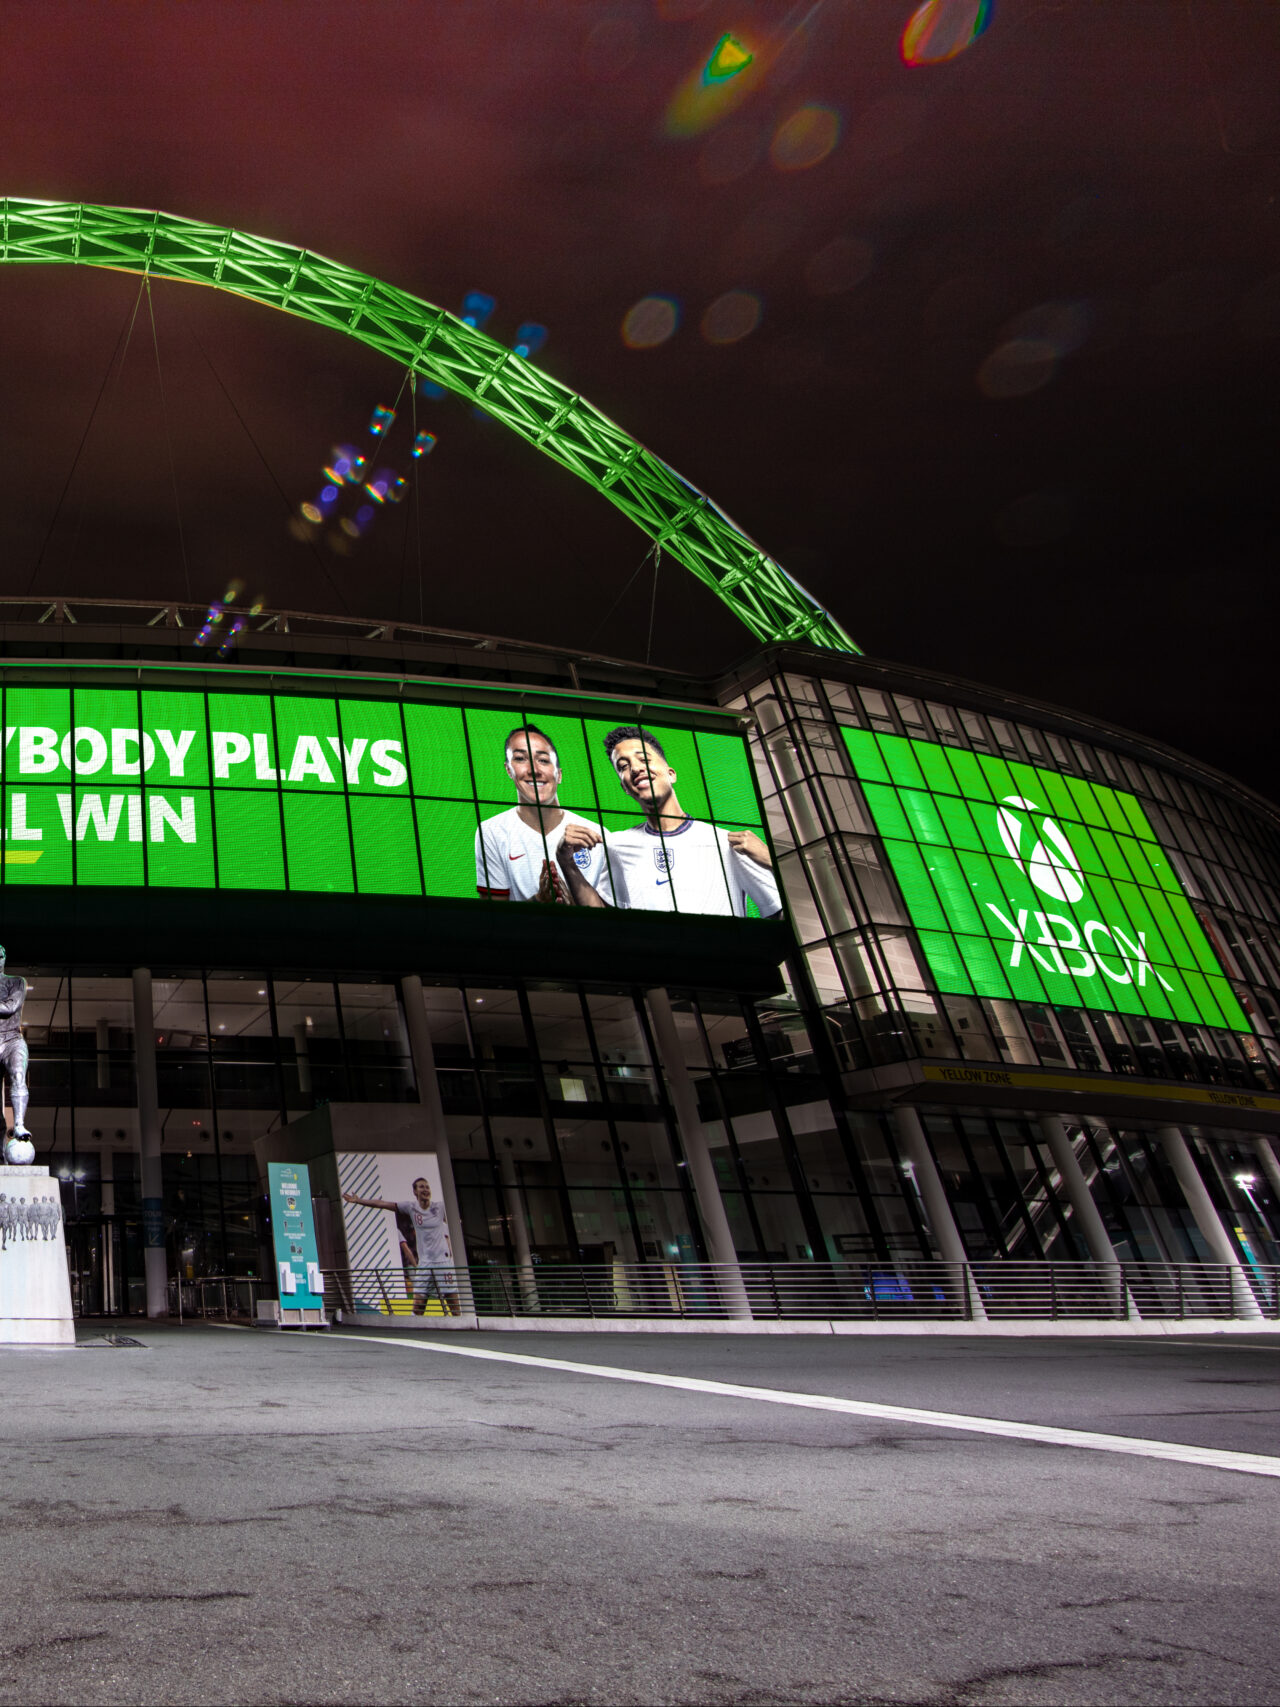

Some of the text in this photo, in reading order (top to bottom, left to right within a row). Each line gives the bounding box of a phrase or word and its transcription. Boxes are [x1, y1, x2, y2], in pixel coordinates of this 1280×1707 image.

[214, 731, 409, 787] PLAYS
[58, 794, 197, 843] WIN
[985, 902, 1175, 991] XBOX
[939, 1068, 1012, 1085] YELLOW ZONE
[1208, 1092, 1237, 1105] YELLOW
[414, 1213, 423, 1226] 18
